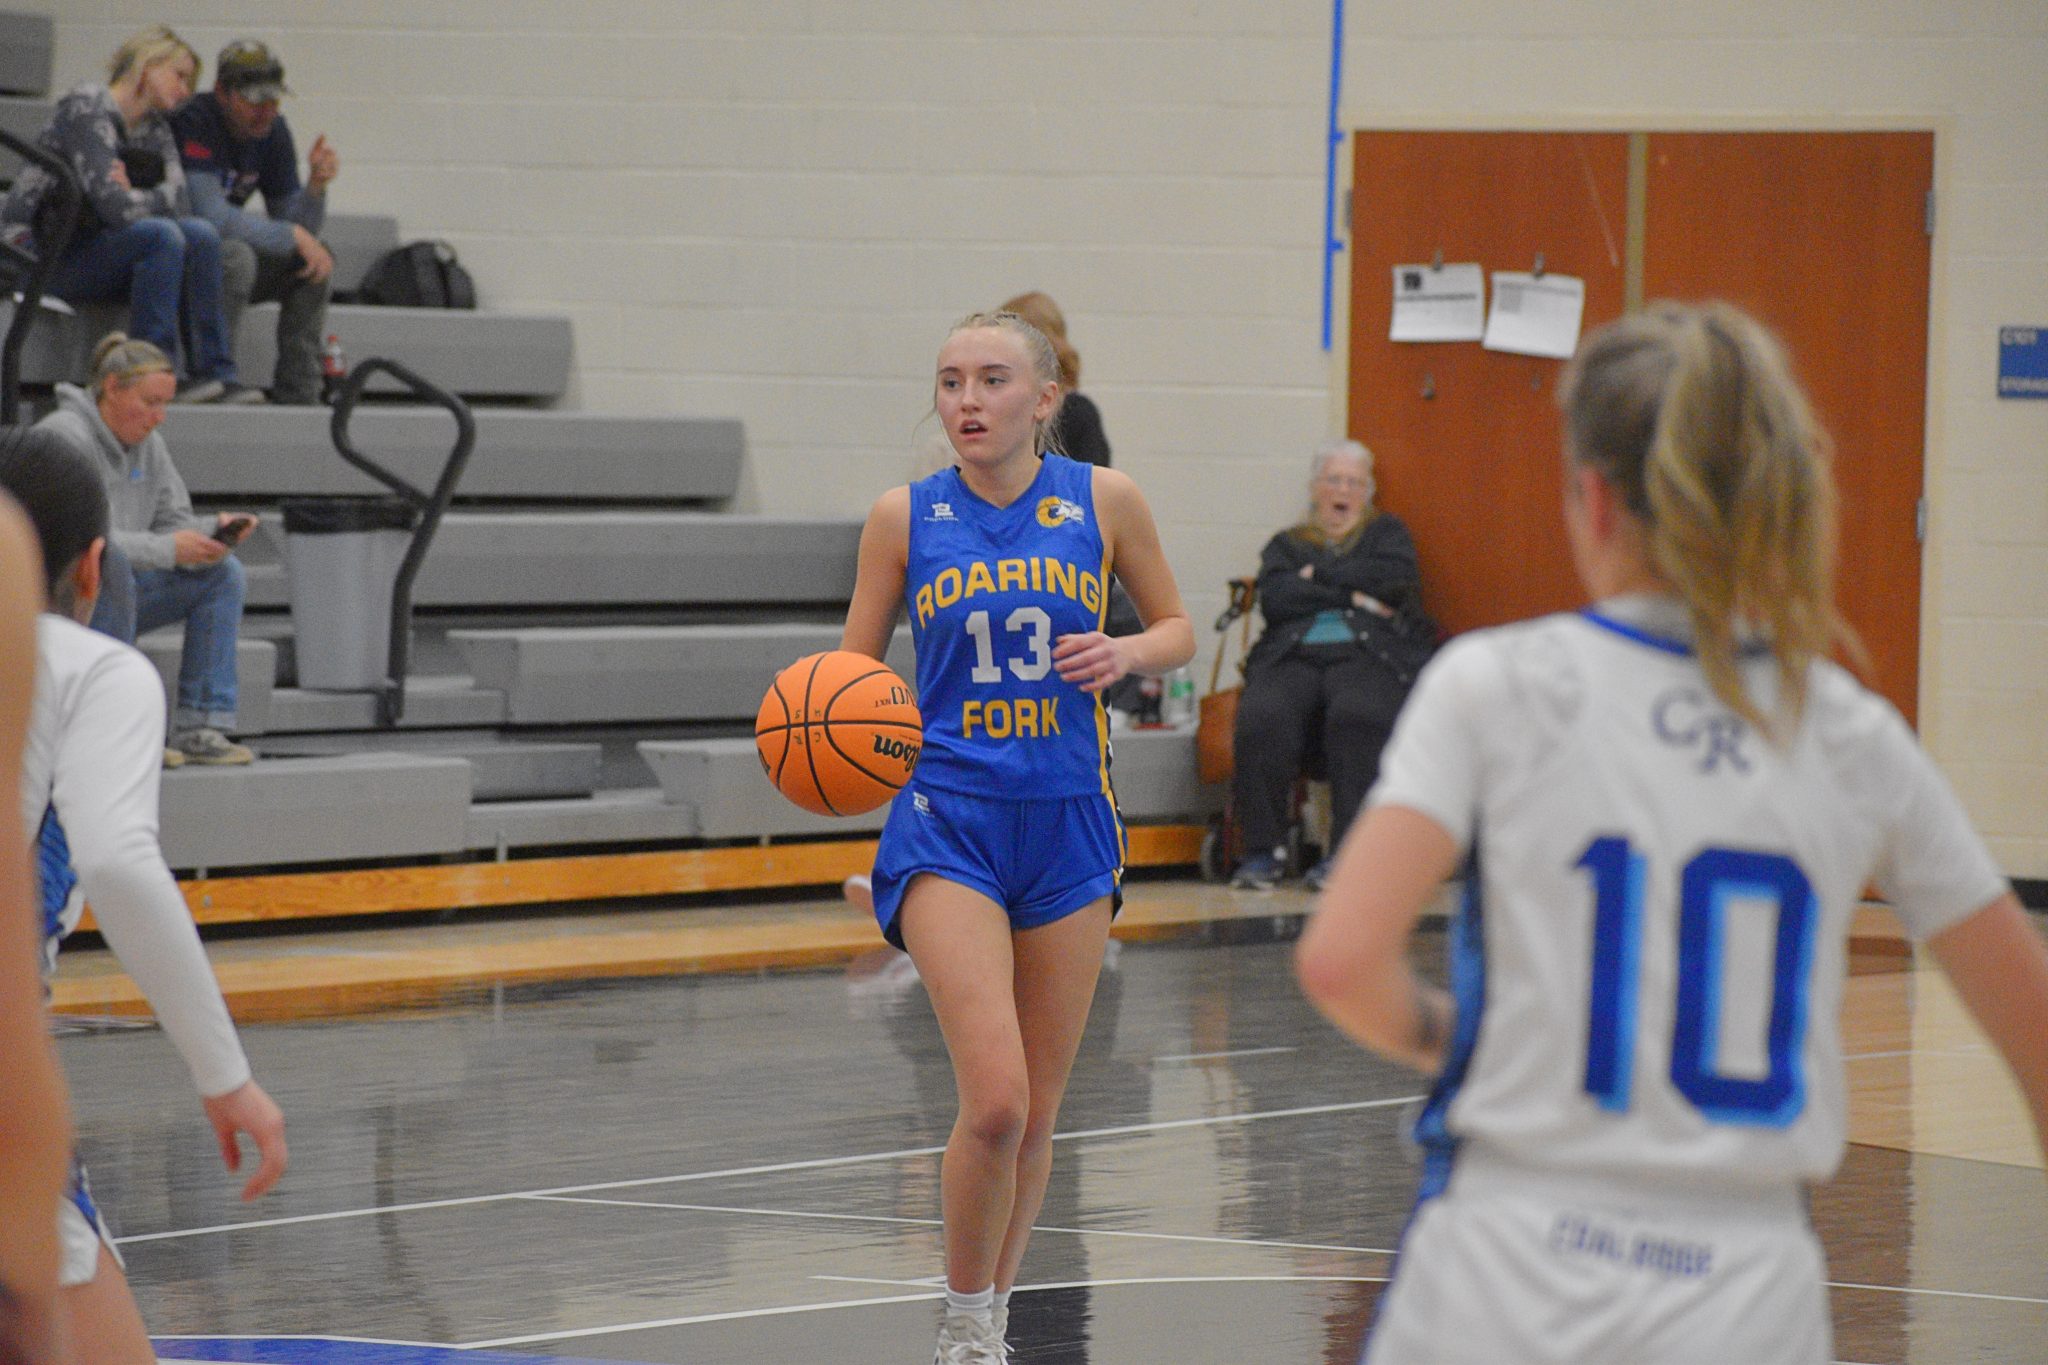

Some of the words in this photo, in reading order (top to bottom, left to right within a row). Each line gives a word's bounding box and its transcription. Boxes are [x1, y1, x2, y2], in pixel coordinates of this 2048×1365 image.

[916, 557, 1100, 631] ROARING
[965, 606, 1051, 683] 13
[962, 696, 1061, 739] FORK
[1652, 688, 1752, 775] CR
[1571, 834, 1819, 1129] 10
